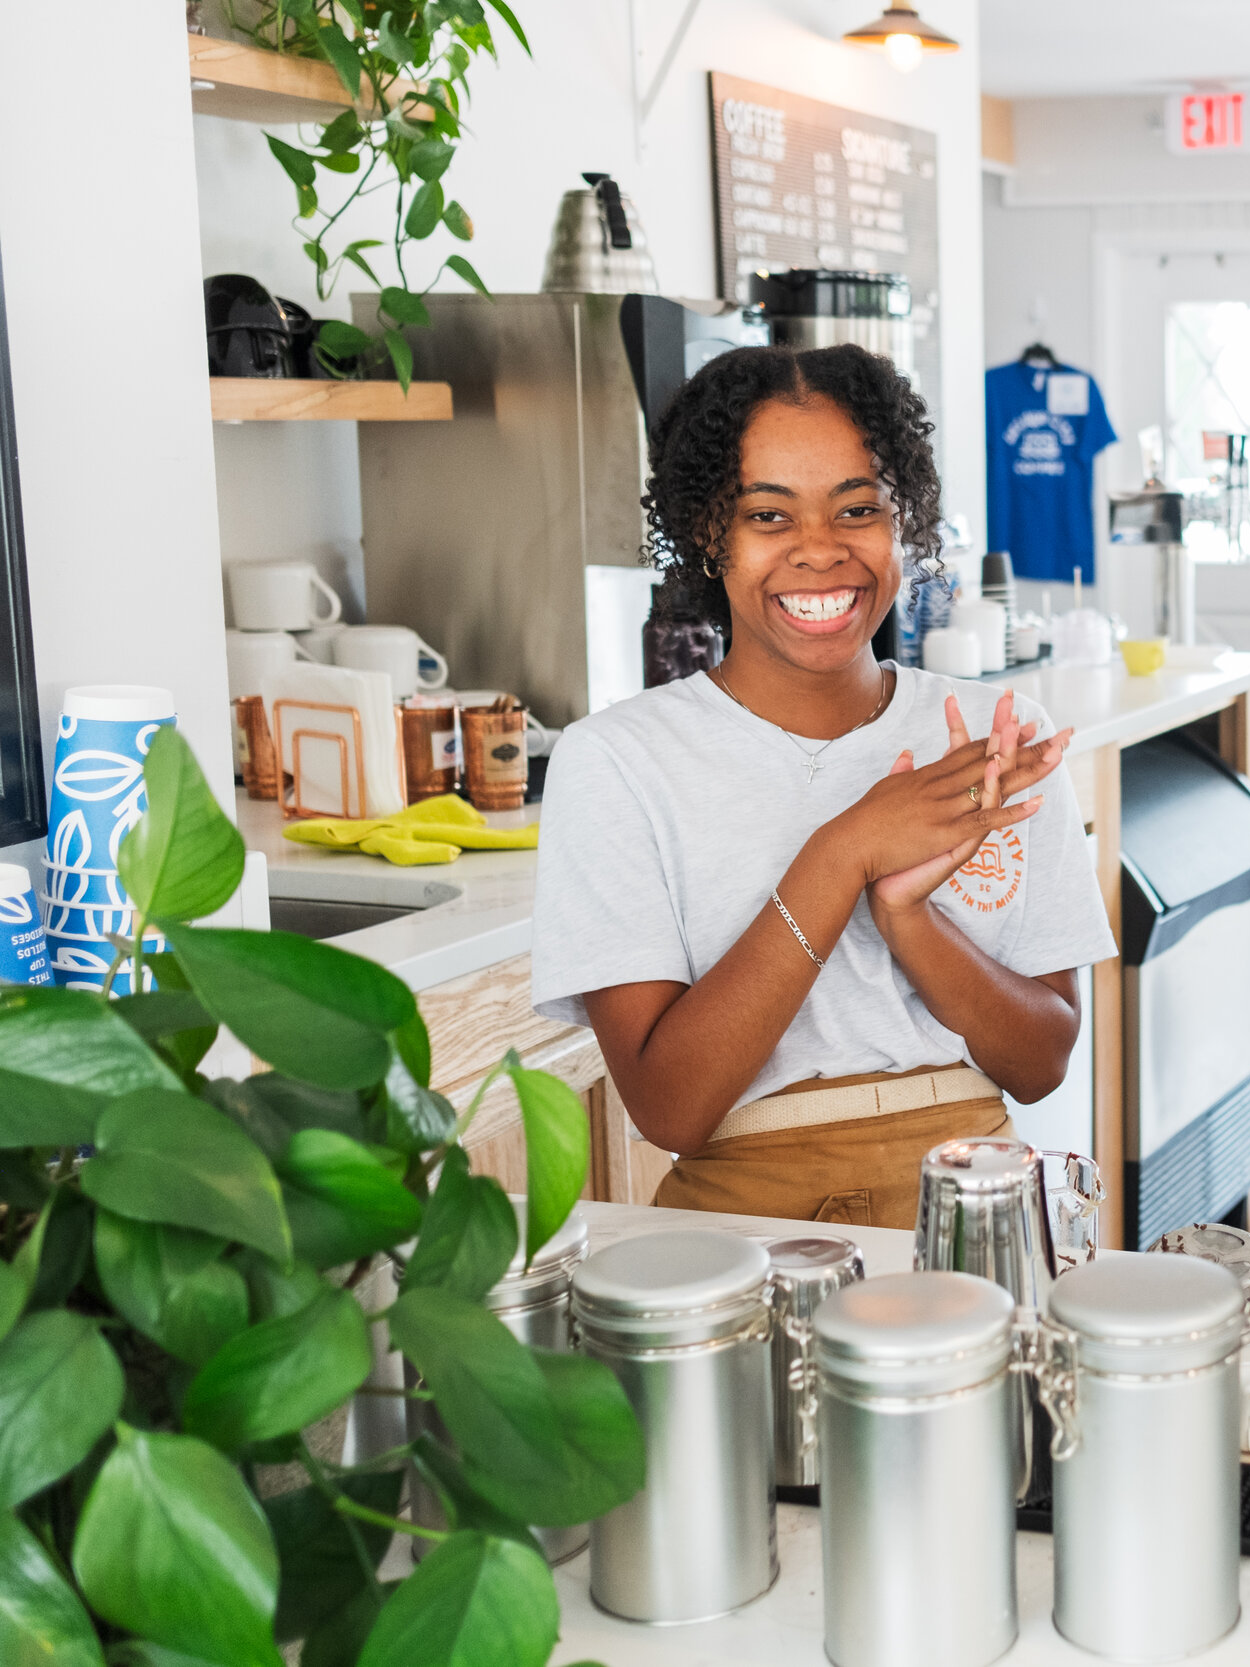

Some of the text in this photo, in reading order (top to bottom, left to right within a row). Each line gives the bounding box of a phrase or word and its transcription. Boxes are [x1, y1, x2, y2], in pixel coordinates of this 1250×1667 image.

[723, 98, 785, 140] COFFEE
[1181, 93, 1244, 148] EXIT
[1002, 829, 1024, 862] ITY
[949, 870, 1021, 912] ET IN THE MIDDLE
[11, 927, 44, 945] RIDGES
[29, 971, 50, 985] THIS
[30, 958, 45, 970] CUP
